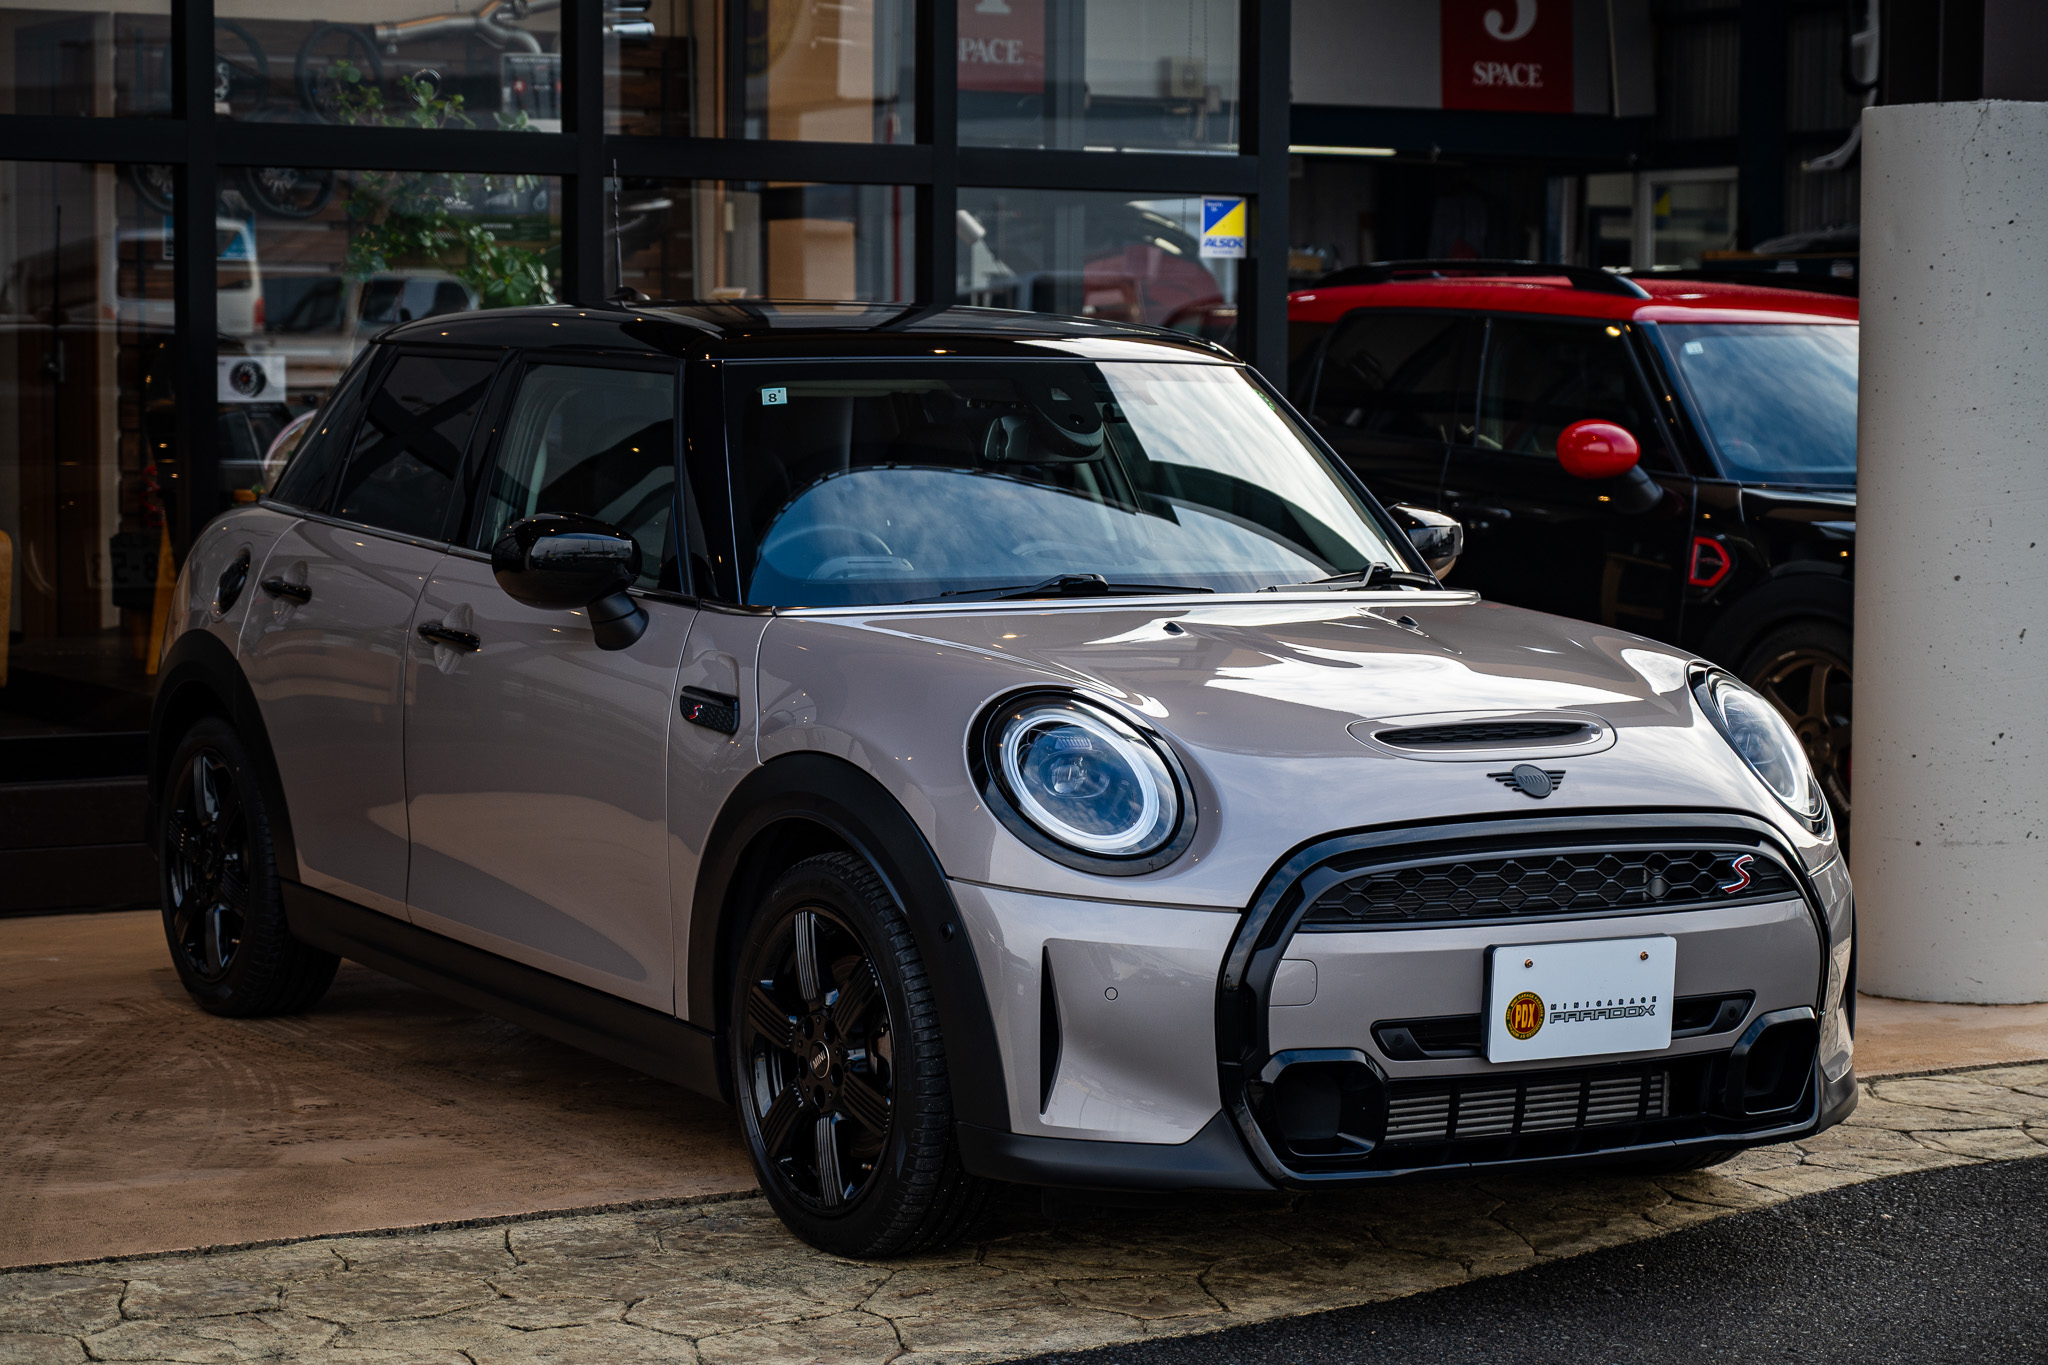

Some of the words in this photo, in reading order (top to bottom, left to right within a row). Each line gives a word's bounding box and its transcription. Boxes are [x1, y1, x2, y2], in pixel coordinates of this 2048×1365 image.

[958, 37, 1024, 65] PACE
[1471, 60, 1545, 88] SPACE
[768, 393, 777, 402] 8
[688, 704, 703, 719] S
[1519, 774, 1546, 784] MINI
[1721, 854, 1755, 894] S
[1515, 1003, 1536, 1029] PDX
[1549, 1004, 1656, 1024] PARADOX
[812, 1050, 826, 1070] MINI
